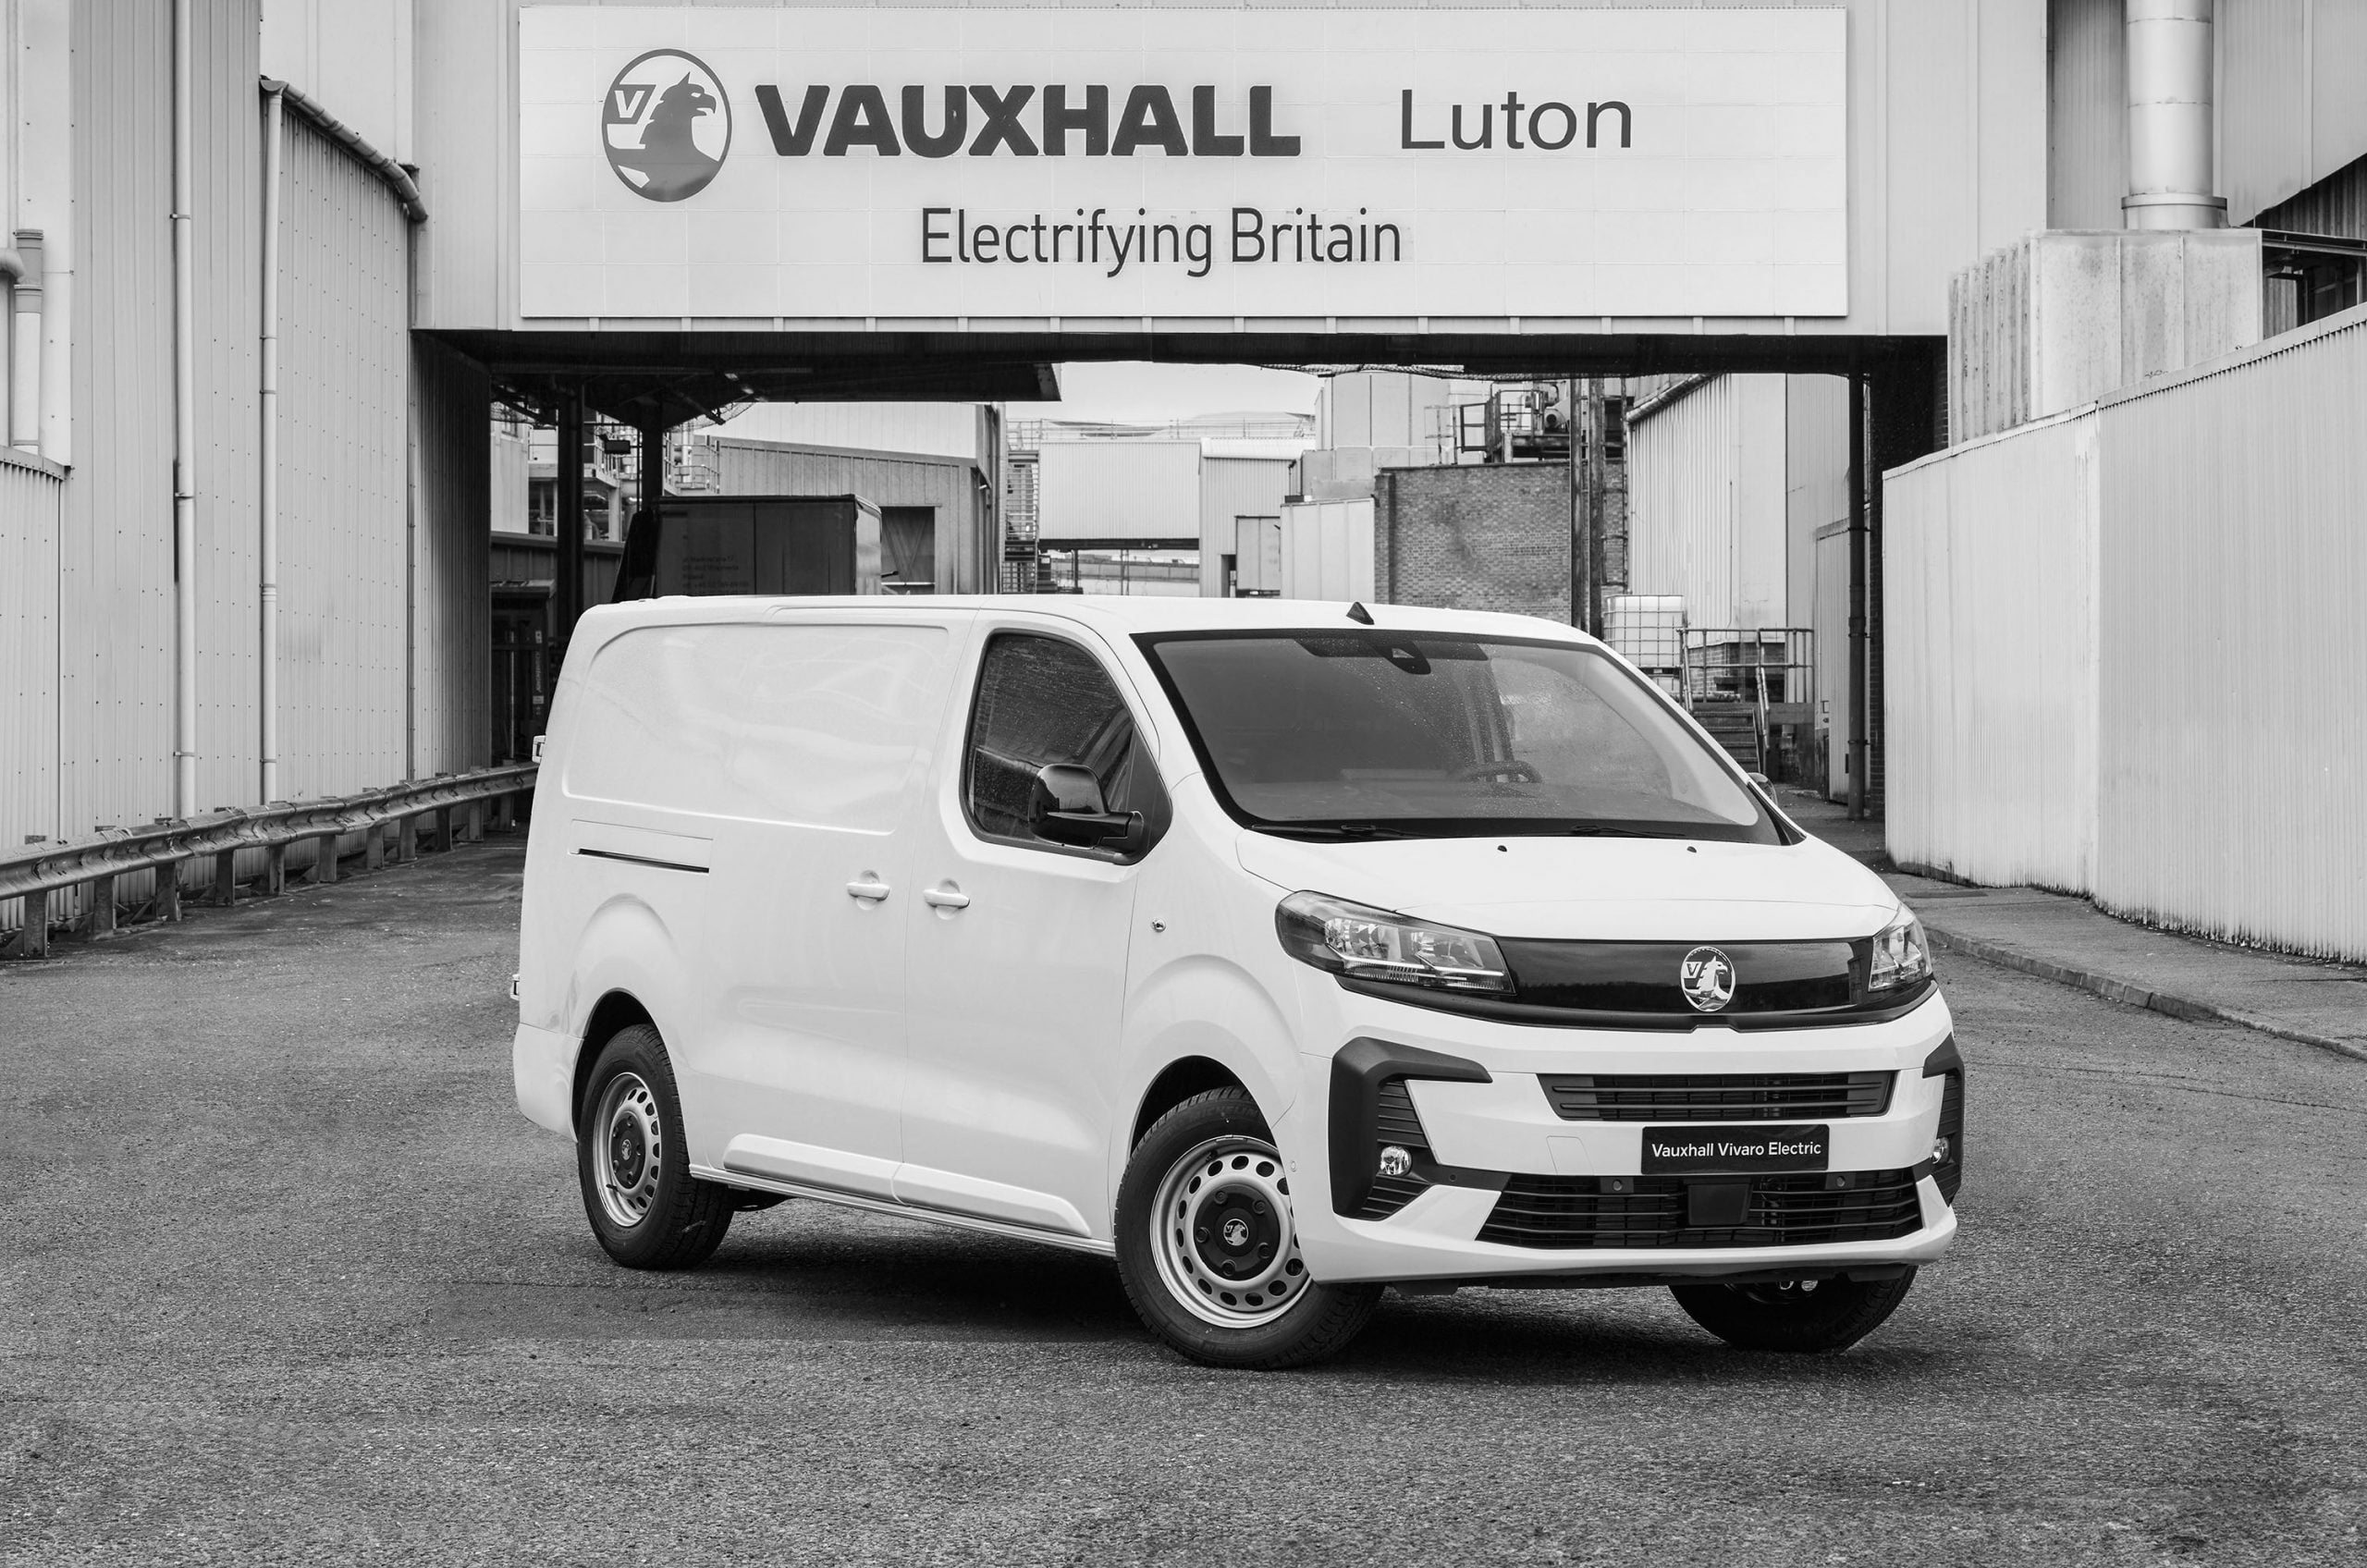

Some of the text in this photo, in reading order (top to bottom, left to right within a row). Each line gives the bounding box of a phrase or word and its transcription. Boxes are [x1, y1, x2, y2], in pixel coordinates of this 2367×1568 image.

[614, 90, 645, 118] V
[754, 84, 1632, 158] VAUXHALL Luton
[922, 207, 1401, 278] Electrifying Britain
[1651, 1141, 1821, 1158] Vauxhall Vivaro Electric
